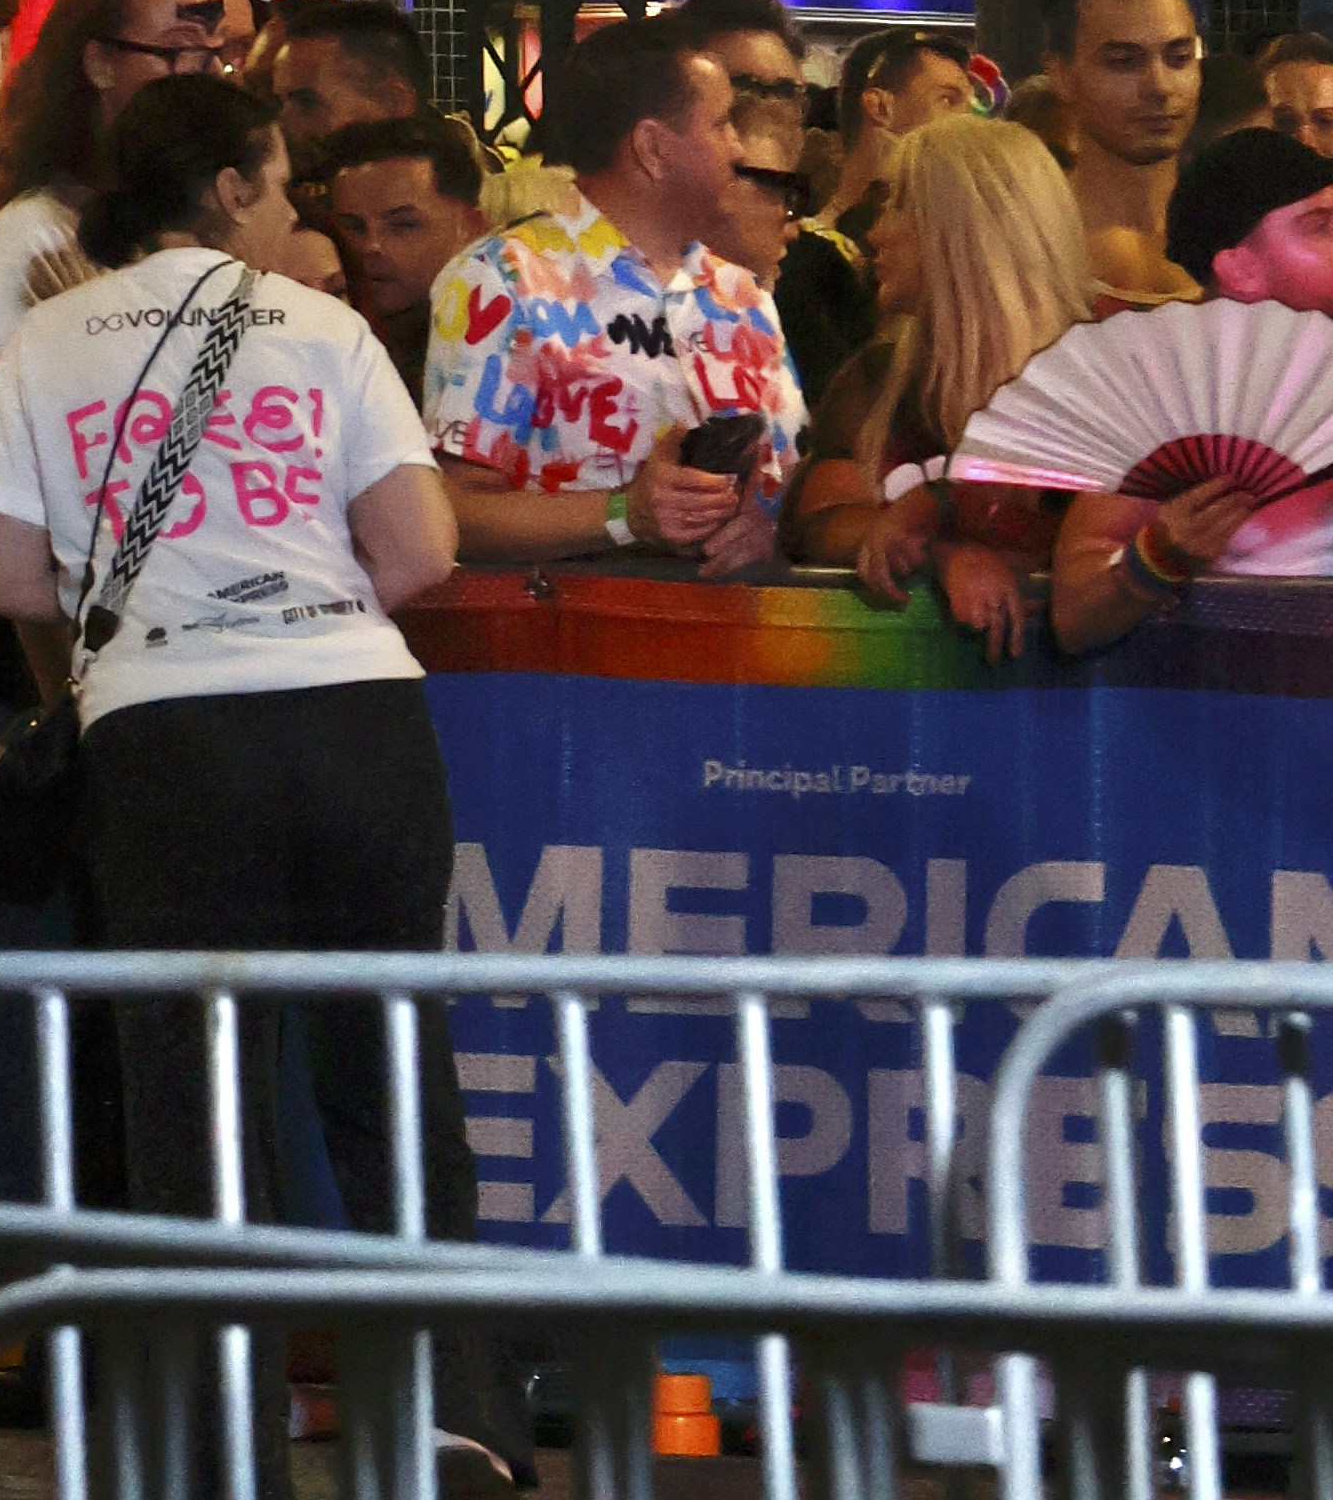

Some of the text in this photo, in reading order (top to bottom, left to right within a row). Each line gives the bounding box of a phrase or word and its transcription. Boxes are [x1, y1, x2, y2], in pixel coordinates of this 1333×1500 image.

[229, 461, 323, 527] BE
[703, 760, 972, 802] Principal Partner
[453, 1052, 1333, 1256] EXPRES
